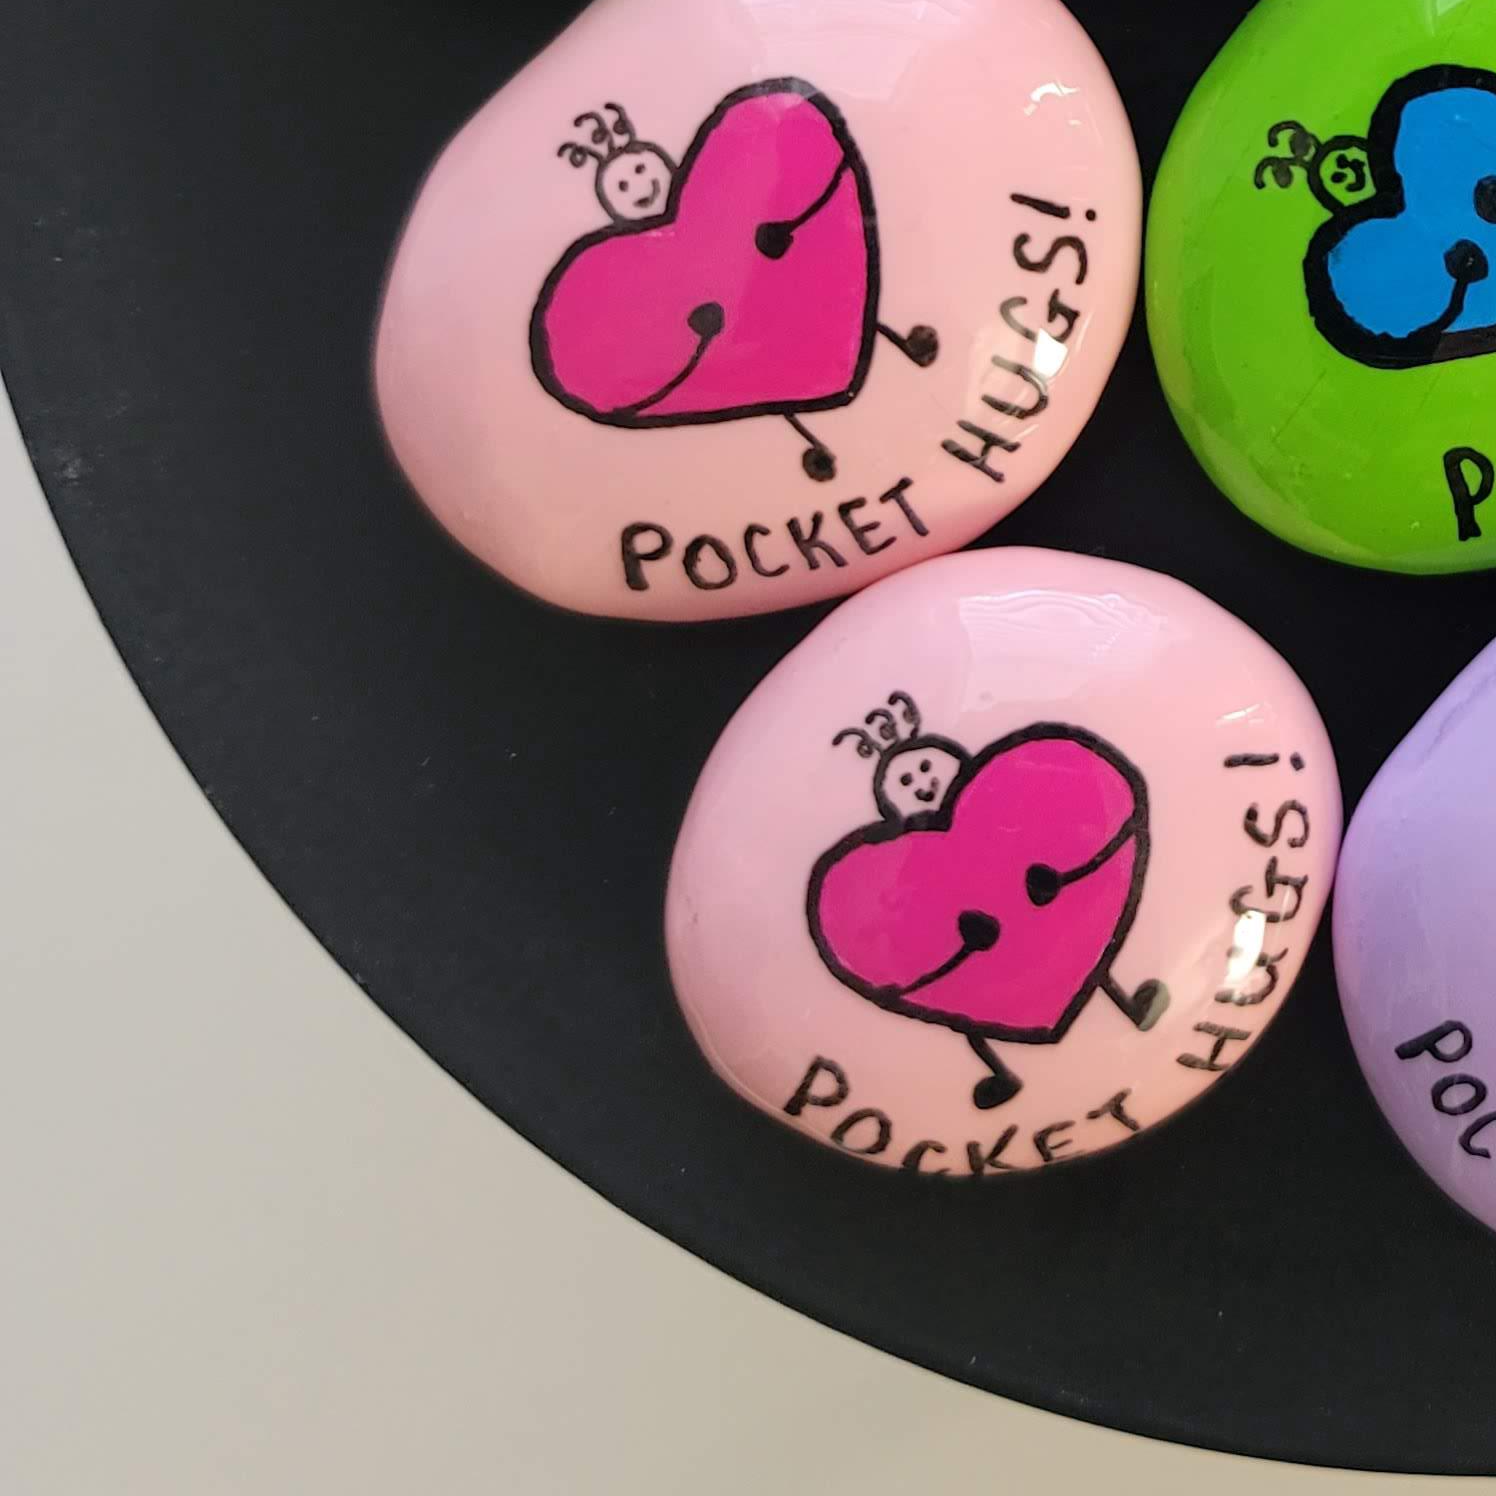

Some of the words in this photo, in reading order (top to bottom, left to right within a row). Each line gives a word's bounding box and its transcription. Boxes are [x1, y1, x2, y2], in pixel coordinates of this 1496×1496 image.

[620, 476, 930, 592] POCKET
[940, 192, 1098, 484] HUGS!
[783, 1055, 1140, 1177] POCKET
[1176, 750, 1310, 1073] HUGS!
